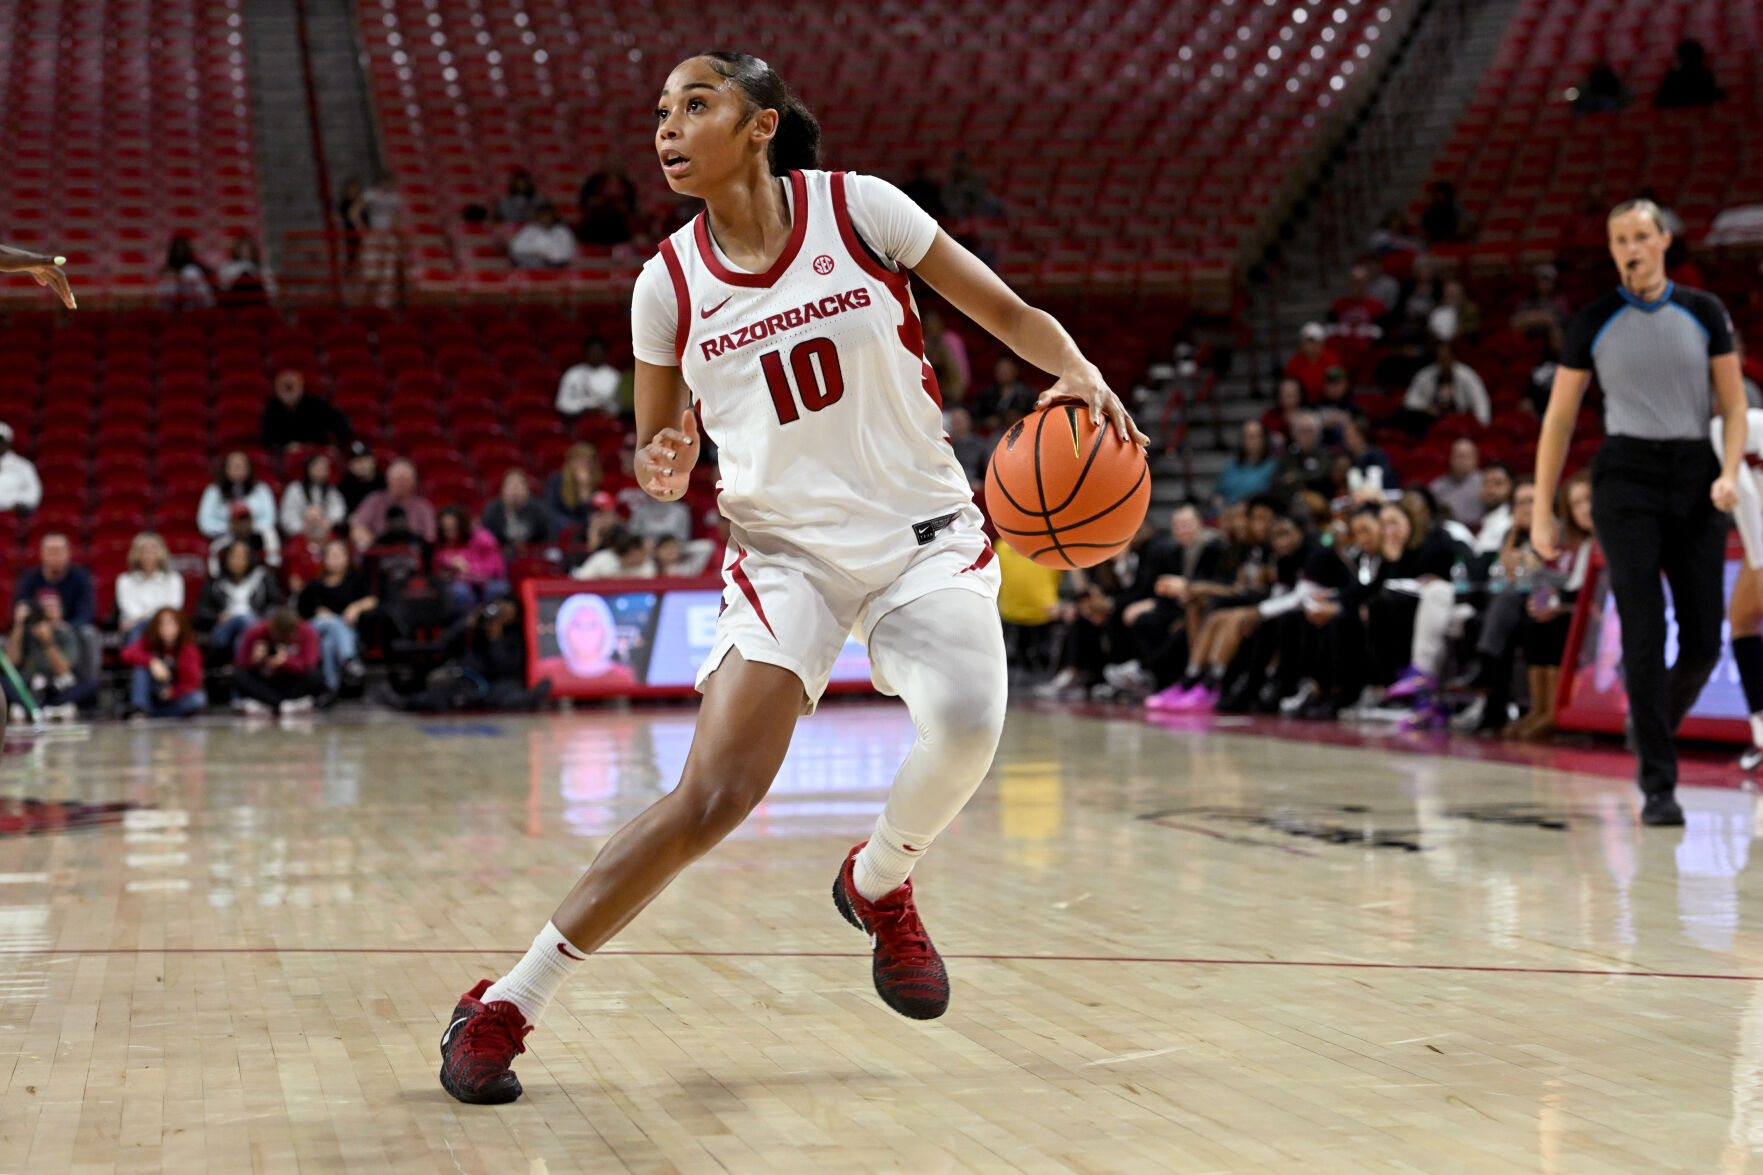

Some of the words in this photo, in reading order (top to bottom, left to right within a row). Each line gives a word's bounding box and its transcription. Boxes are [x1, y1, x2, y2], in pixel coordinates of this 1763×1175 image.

[815, 257, 833, 273] SEC
[699, 287, 871, 361] RAZORBACKS
[760, 337, 844, 425] 10
